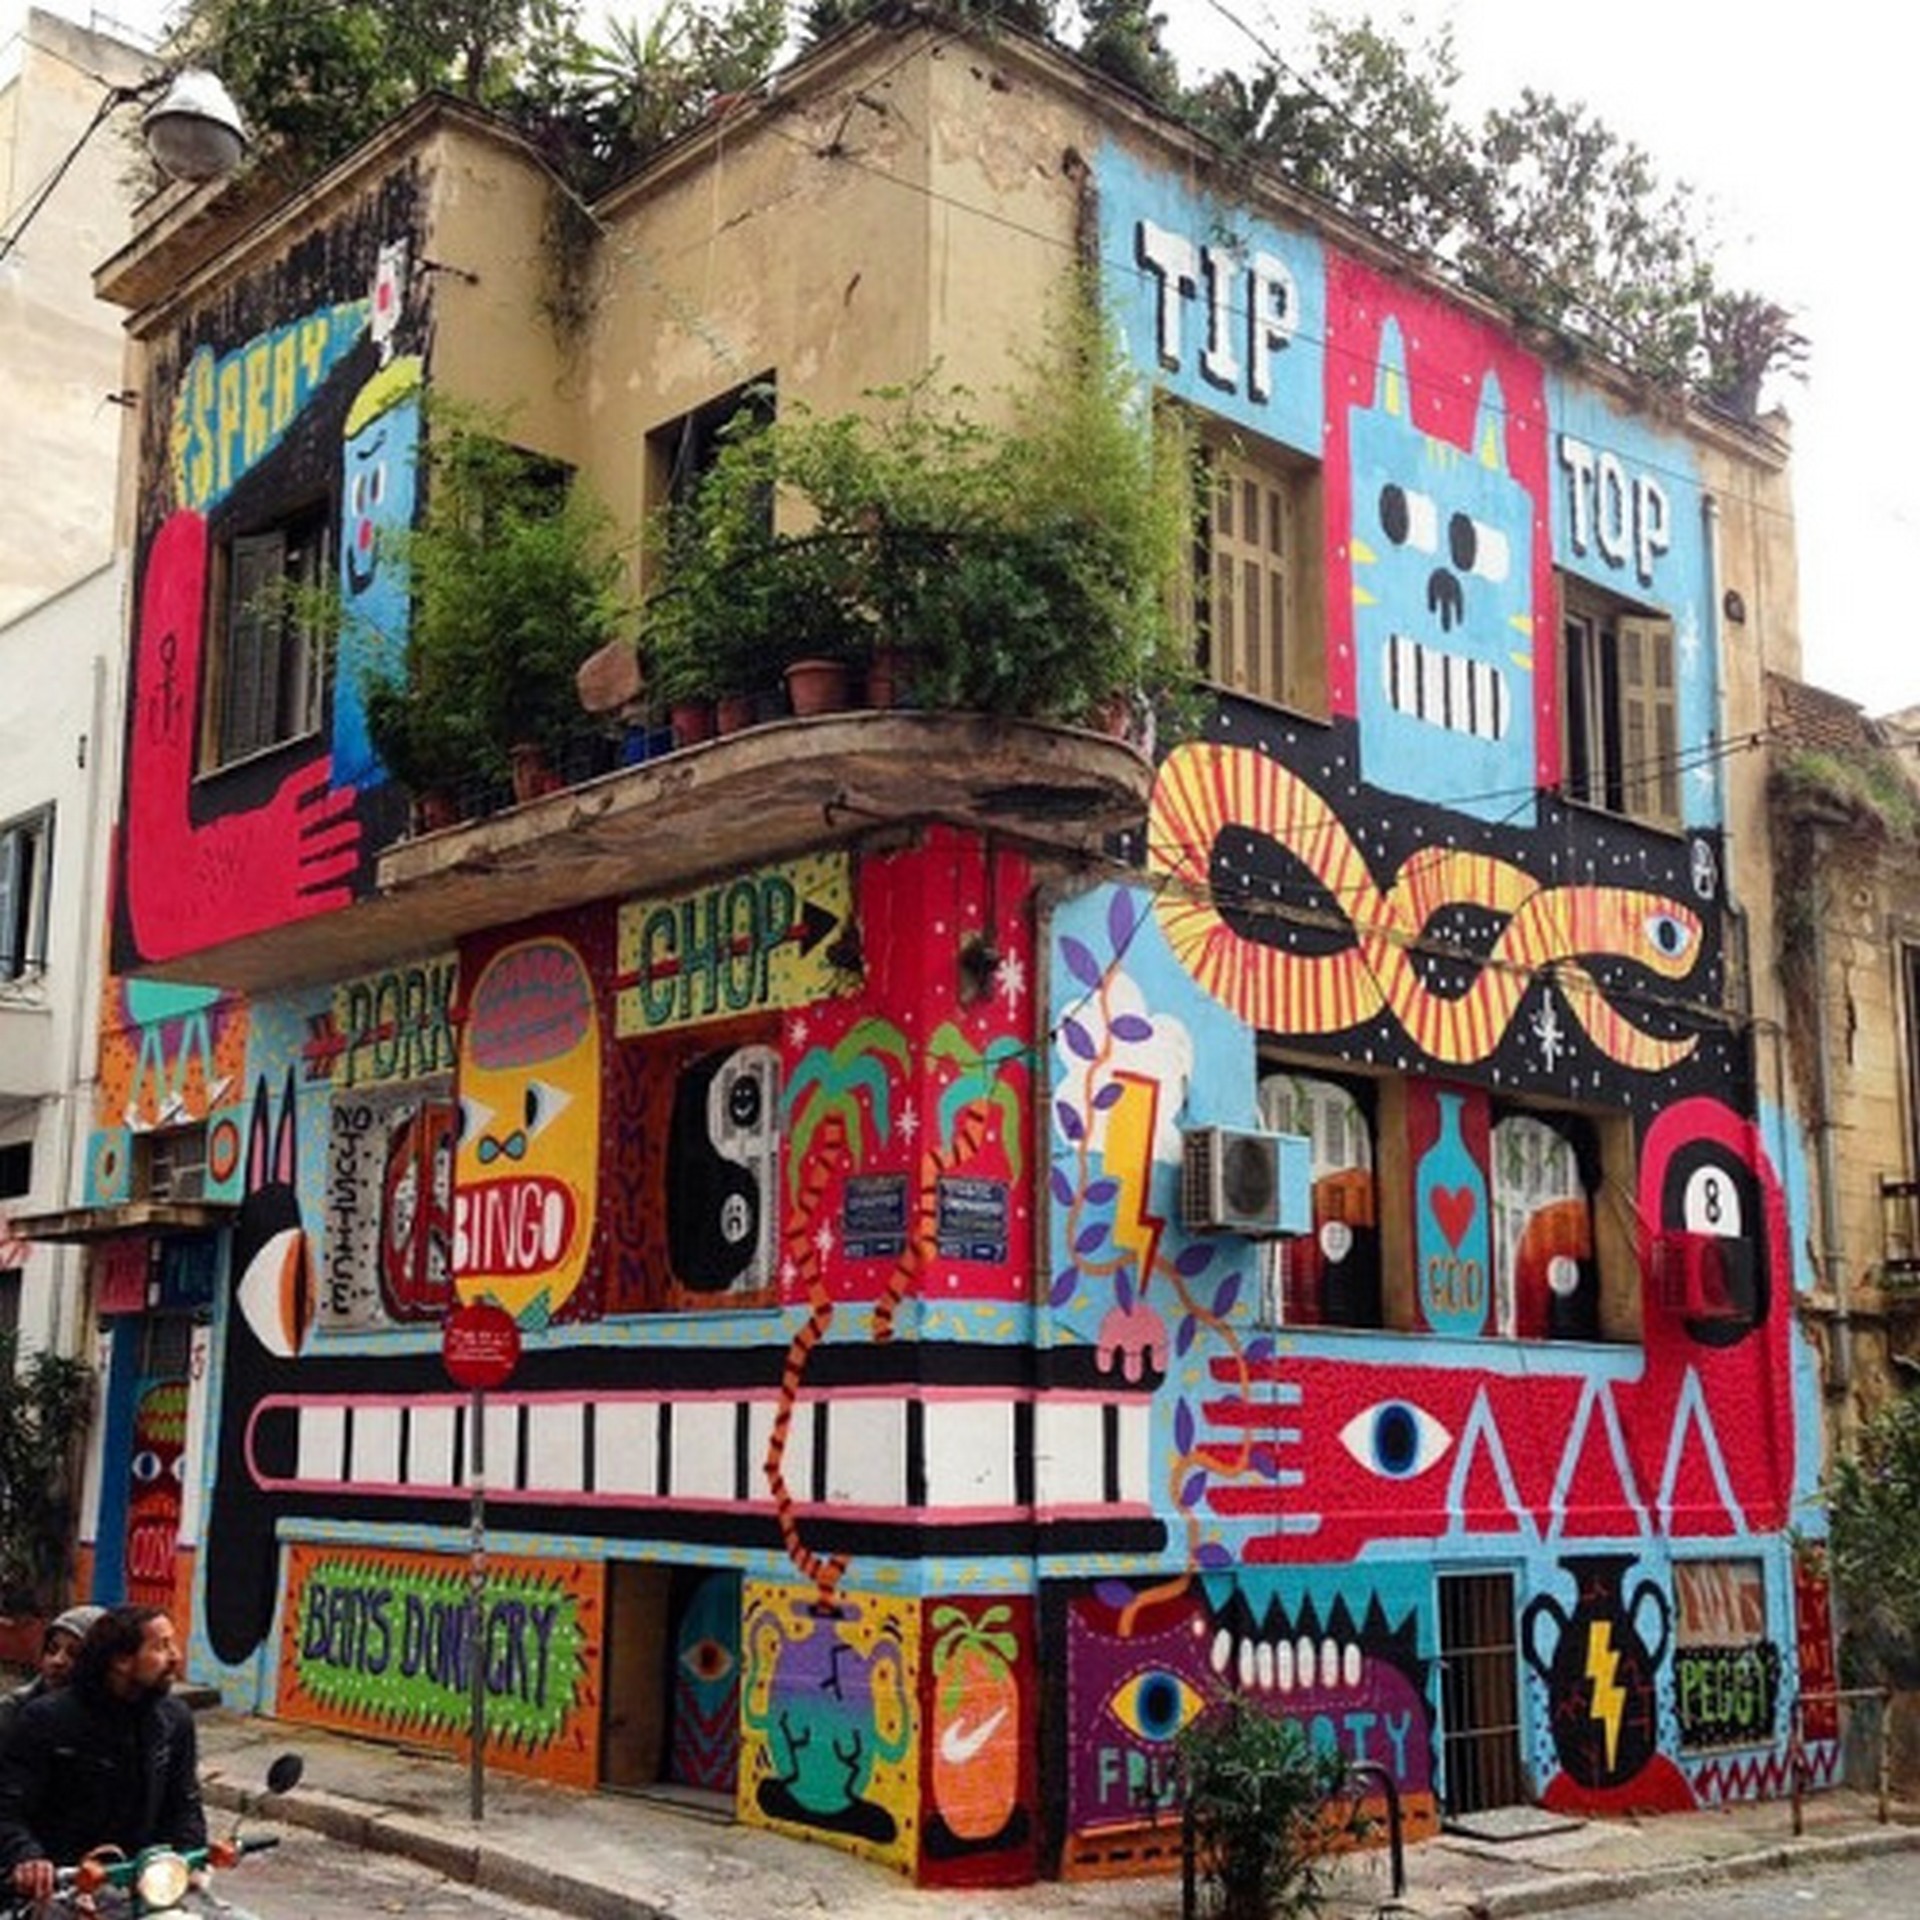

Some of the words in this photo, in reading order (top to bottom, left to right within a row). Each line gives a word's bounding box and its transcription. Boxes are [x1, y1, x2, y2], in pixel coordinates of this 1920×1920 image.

[1135, 219, 1298, 406] TIP
[190, 318, 328, 505] SPRAY
[1557, 433, 1671, 588] TOP
[640, 874, 796, 1027] CHOP
[345, 963, 457, 1087] PORK
[453, 1182, 565, 1271] BINGO
[1703, 1176, 1723, 1225] 8
[487, 1598, 559, 1710] CRY
[1680, 1651, 1767, 1730] PEGGY
